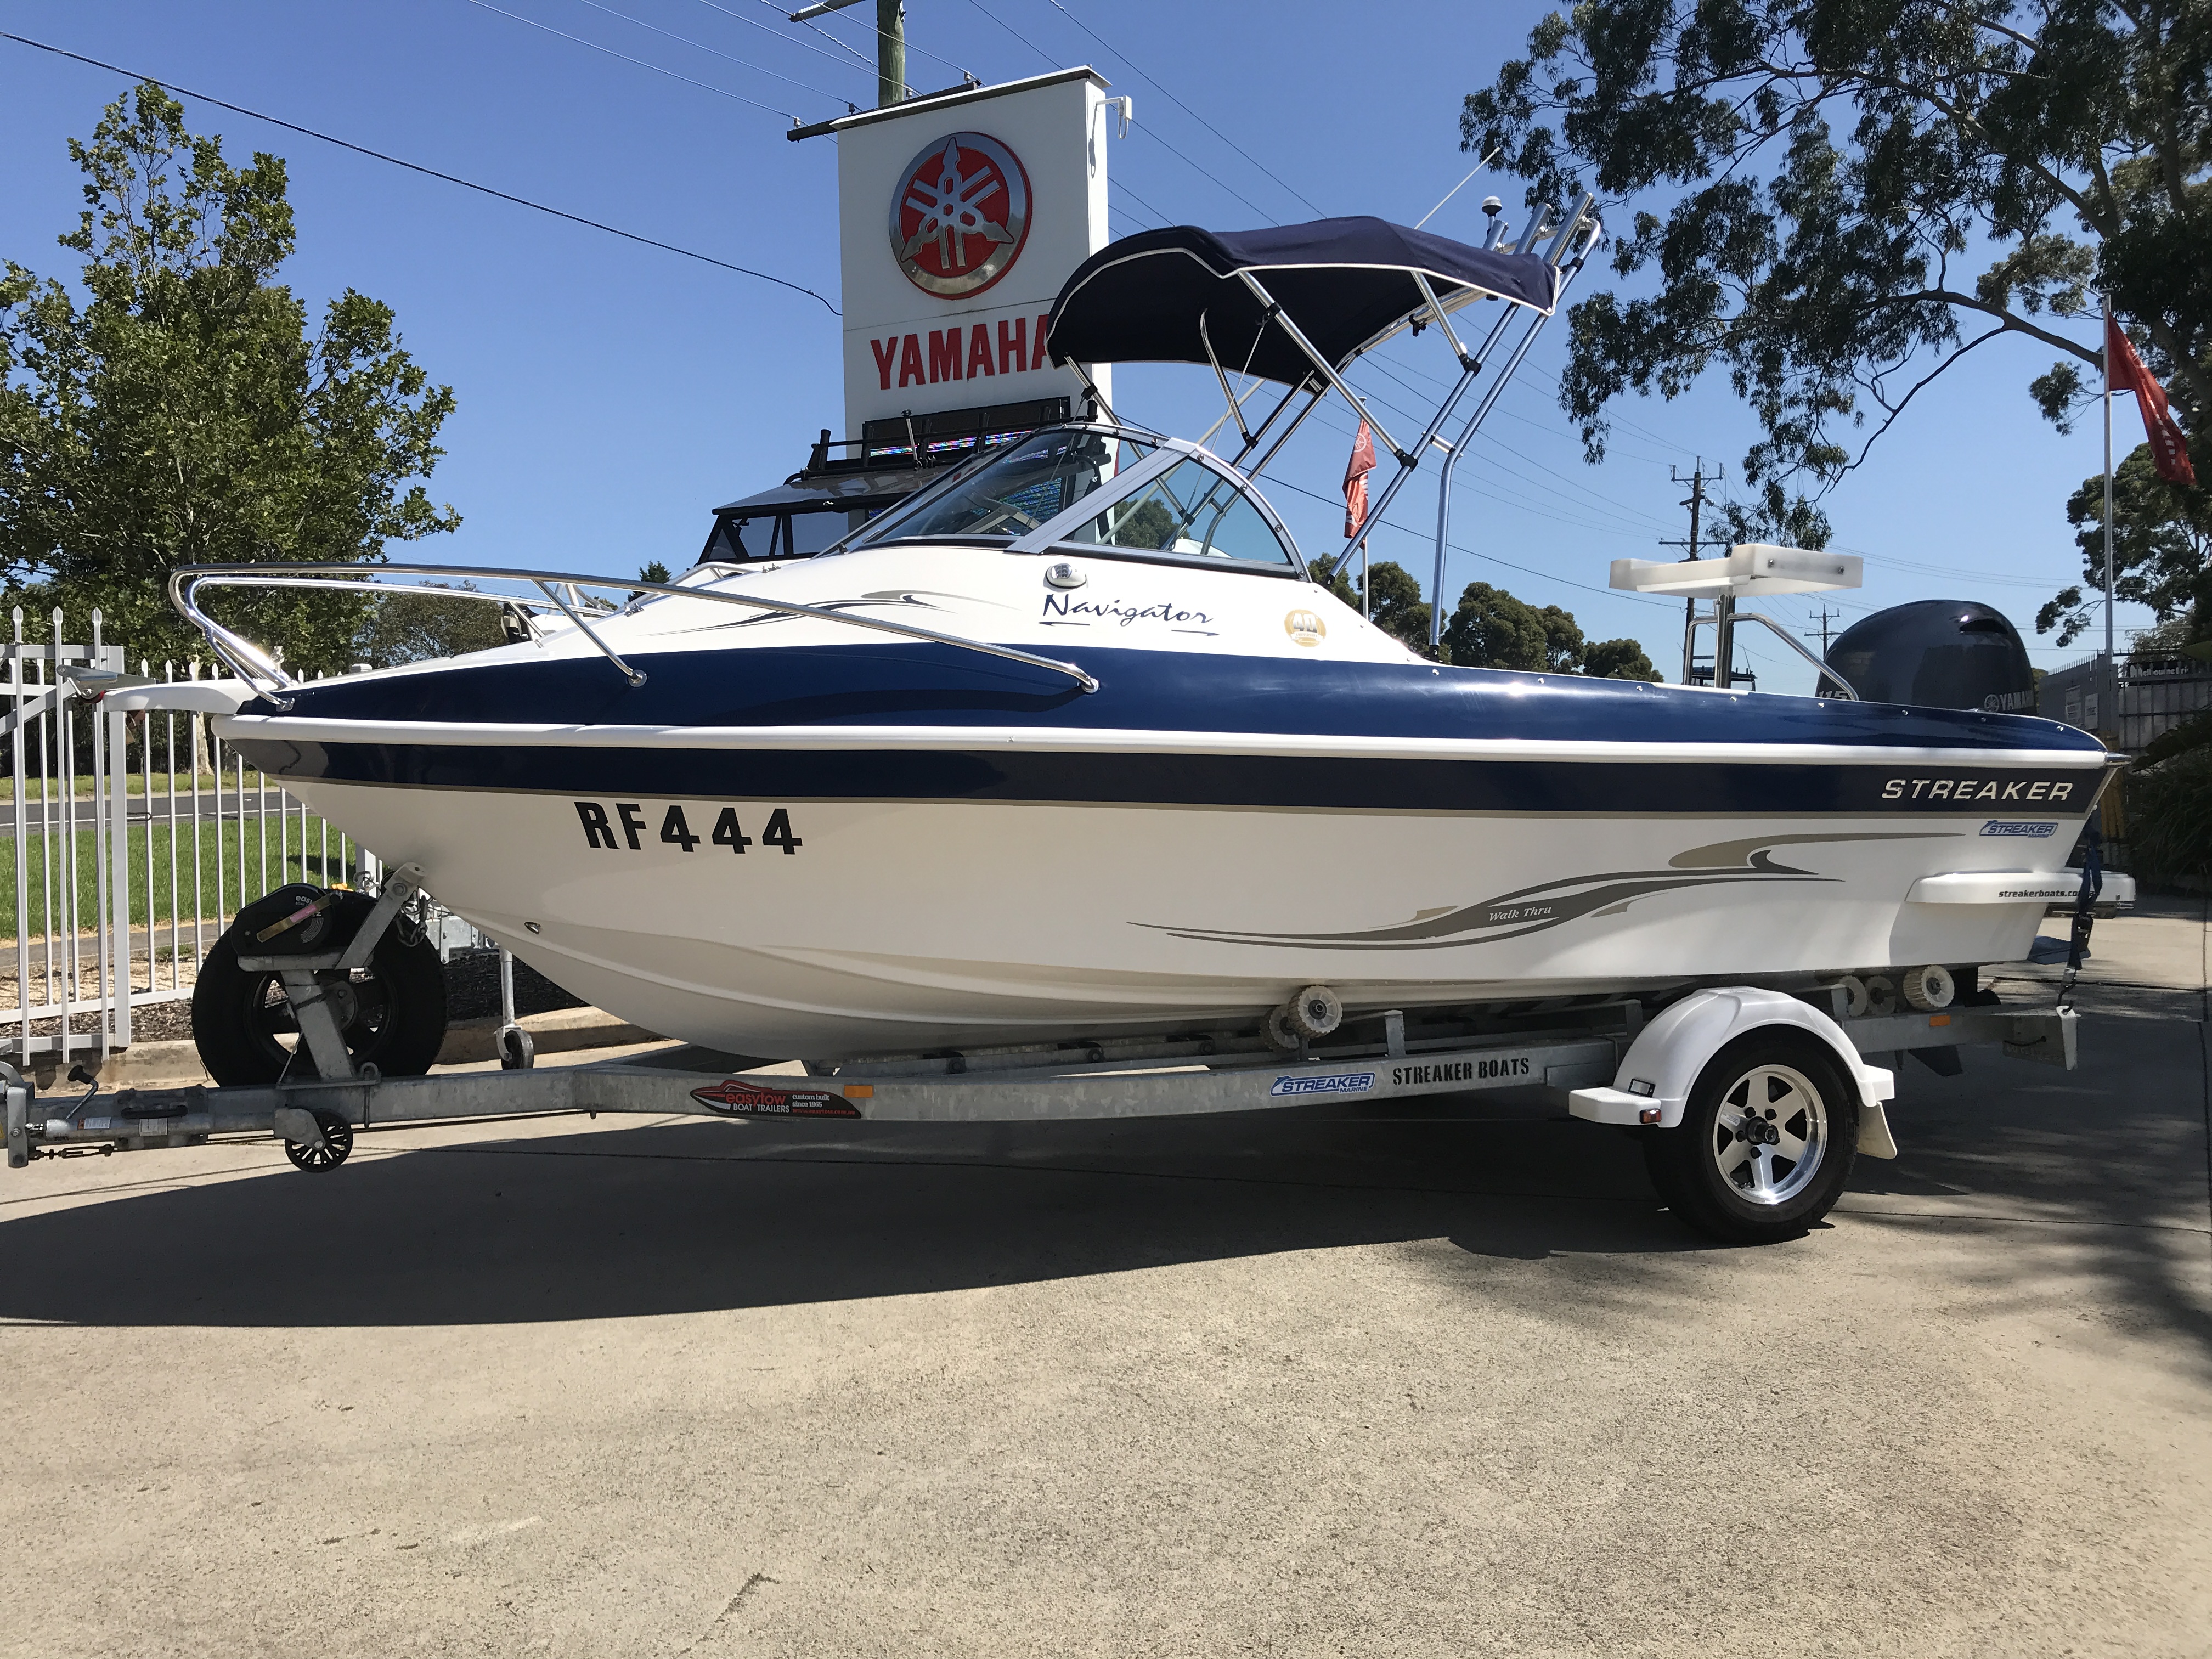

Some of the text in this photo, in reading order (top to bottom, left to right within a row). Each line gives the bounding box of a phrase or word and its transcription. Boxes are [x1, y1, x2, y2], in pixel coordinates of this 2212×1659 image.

[871, 314, 1049, 390] YAMAHA
[1043, 593, 1214, 627] Navigator
[1293, 613, 1318, 633] 40
[1999, 690, 2033, 711] YAMA
[1882, 779, 2073, 800] STREAKER
[1988, 824, 2054, 834] STREAKER
[1999, 889, 2095, 898] streakerboats.coa
[1489, 906, 1552, 921] Walk Thru
[1393, 1057, 1530, 1085] STREAKER BOATS
[1282, 1076, 1370, 1092] STREAKER
[725, 1092, 786, 1107] easytow
[733, 1103, 790, 1113] BOAT TRAILERS
